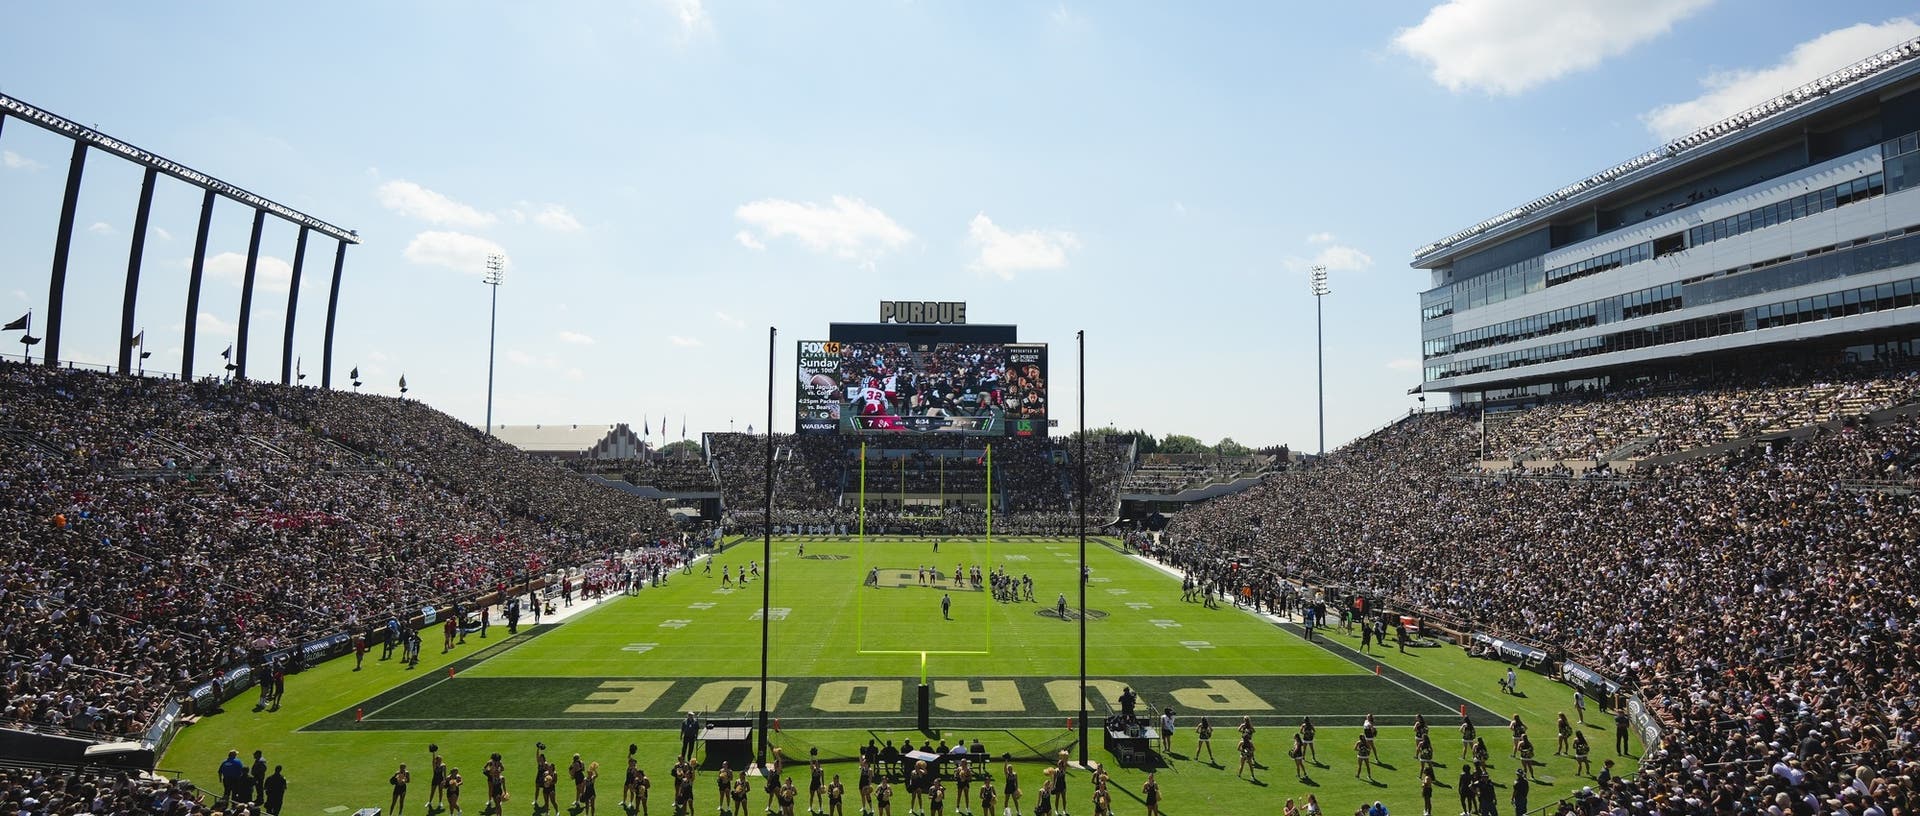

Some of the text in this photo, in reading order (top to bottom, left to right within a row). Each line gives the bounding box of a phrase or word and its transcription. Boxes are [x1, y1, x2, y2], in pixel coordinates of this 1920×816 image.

[880, 301, 966, 324] PURDUE
[801, 342, 838, 353] FOX 16
[800, 358, 839, 370] Sunday
[866, 390, 883, 400] 32
[1501, 645, 1523, 659] TOYOTA
[563, 680, 1275, 712] PURDUE
